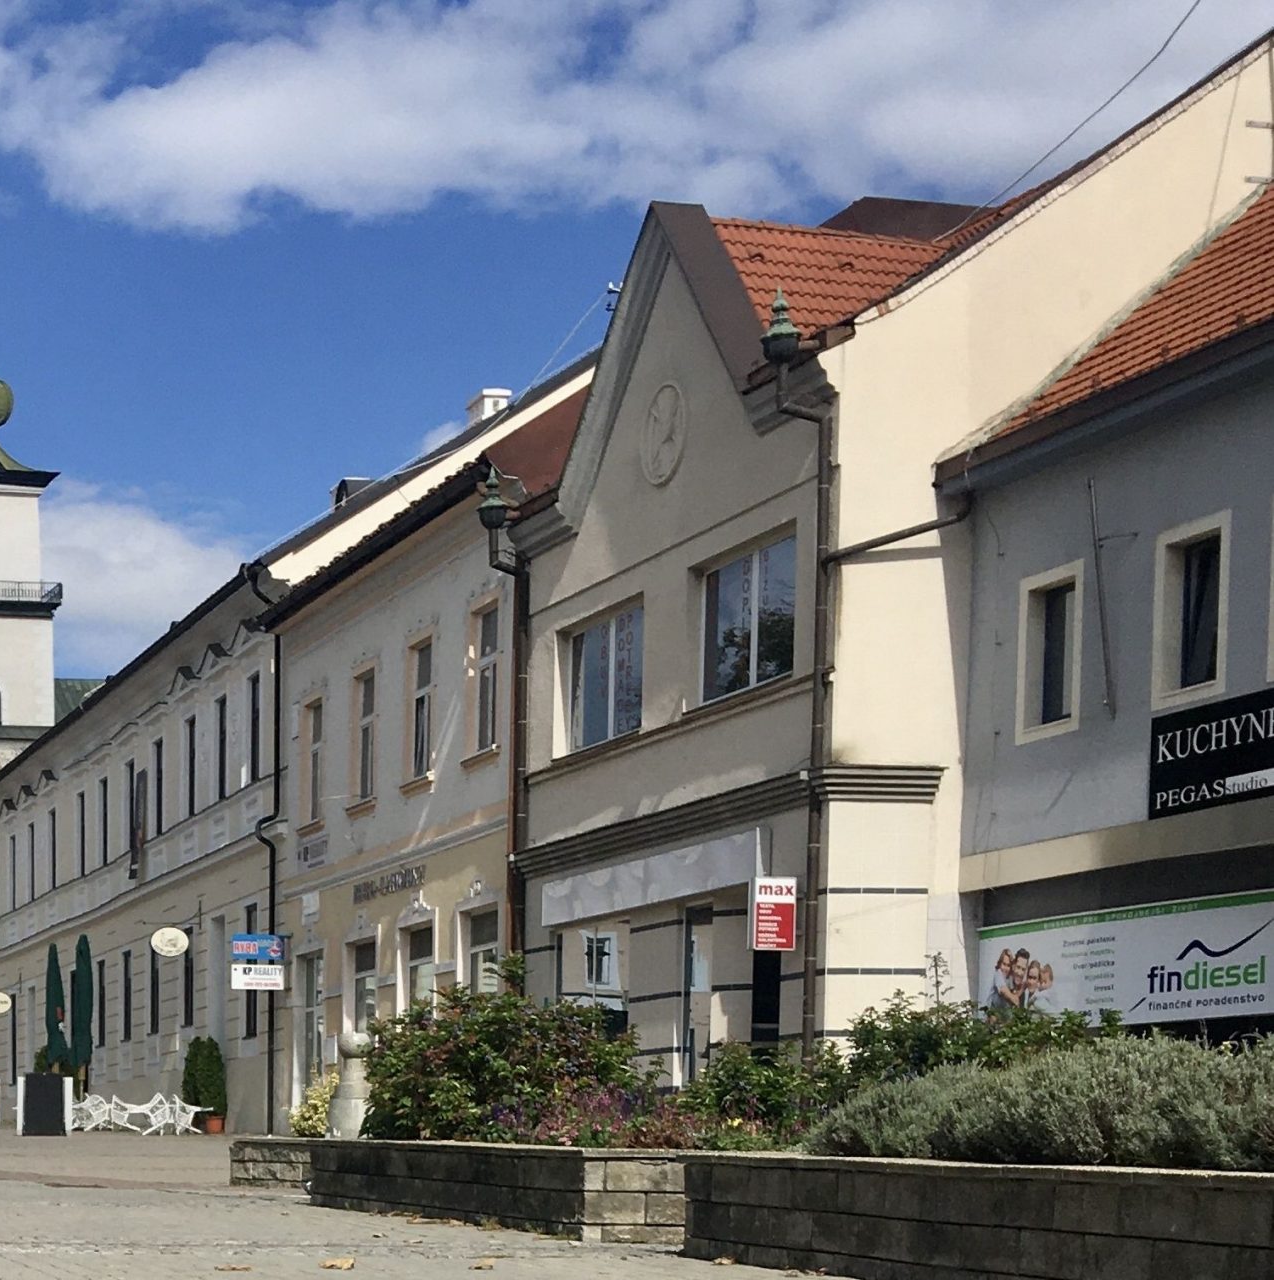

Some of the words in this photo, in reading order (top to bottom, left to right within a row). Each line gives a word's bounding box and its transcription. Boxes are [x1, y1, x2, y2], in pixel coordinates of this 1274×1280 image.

[1155, 779, 1225, 810] PEGAS
[759, 885, 794, 895] max
[242, 967, 252, 976] KP
[253, 966, 282, 977] REALITY
[1147, 955, 1266, 994] findiesel
